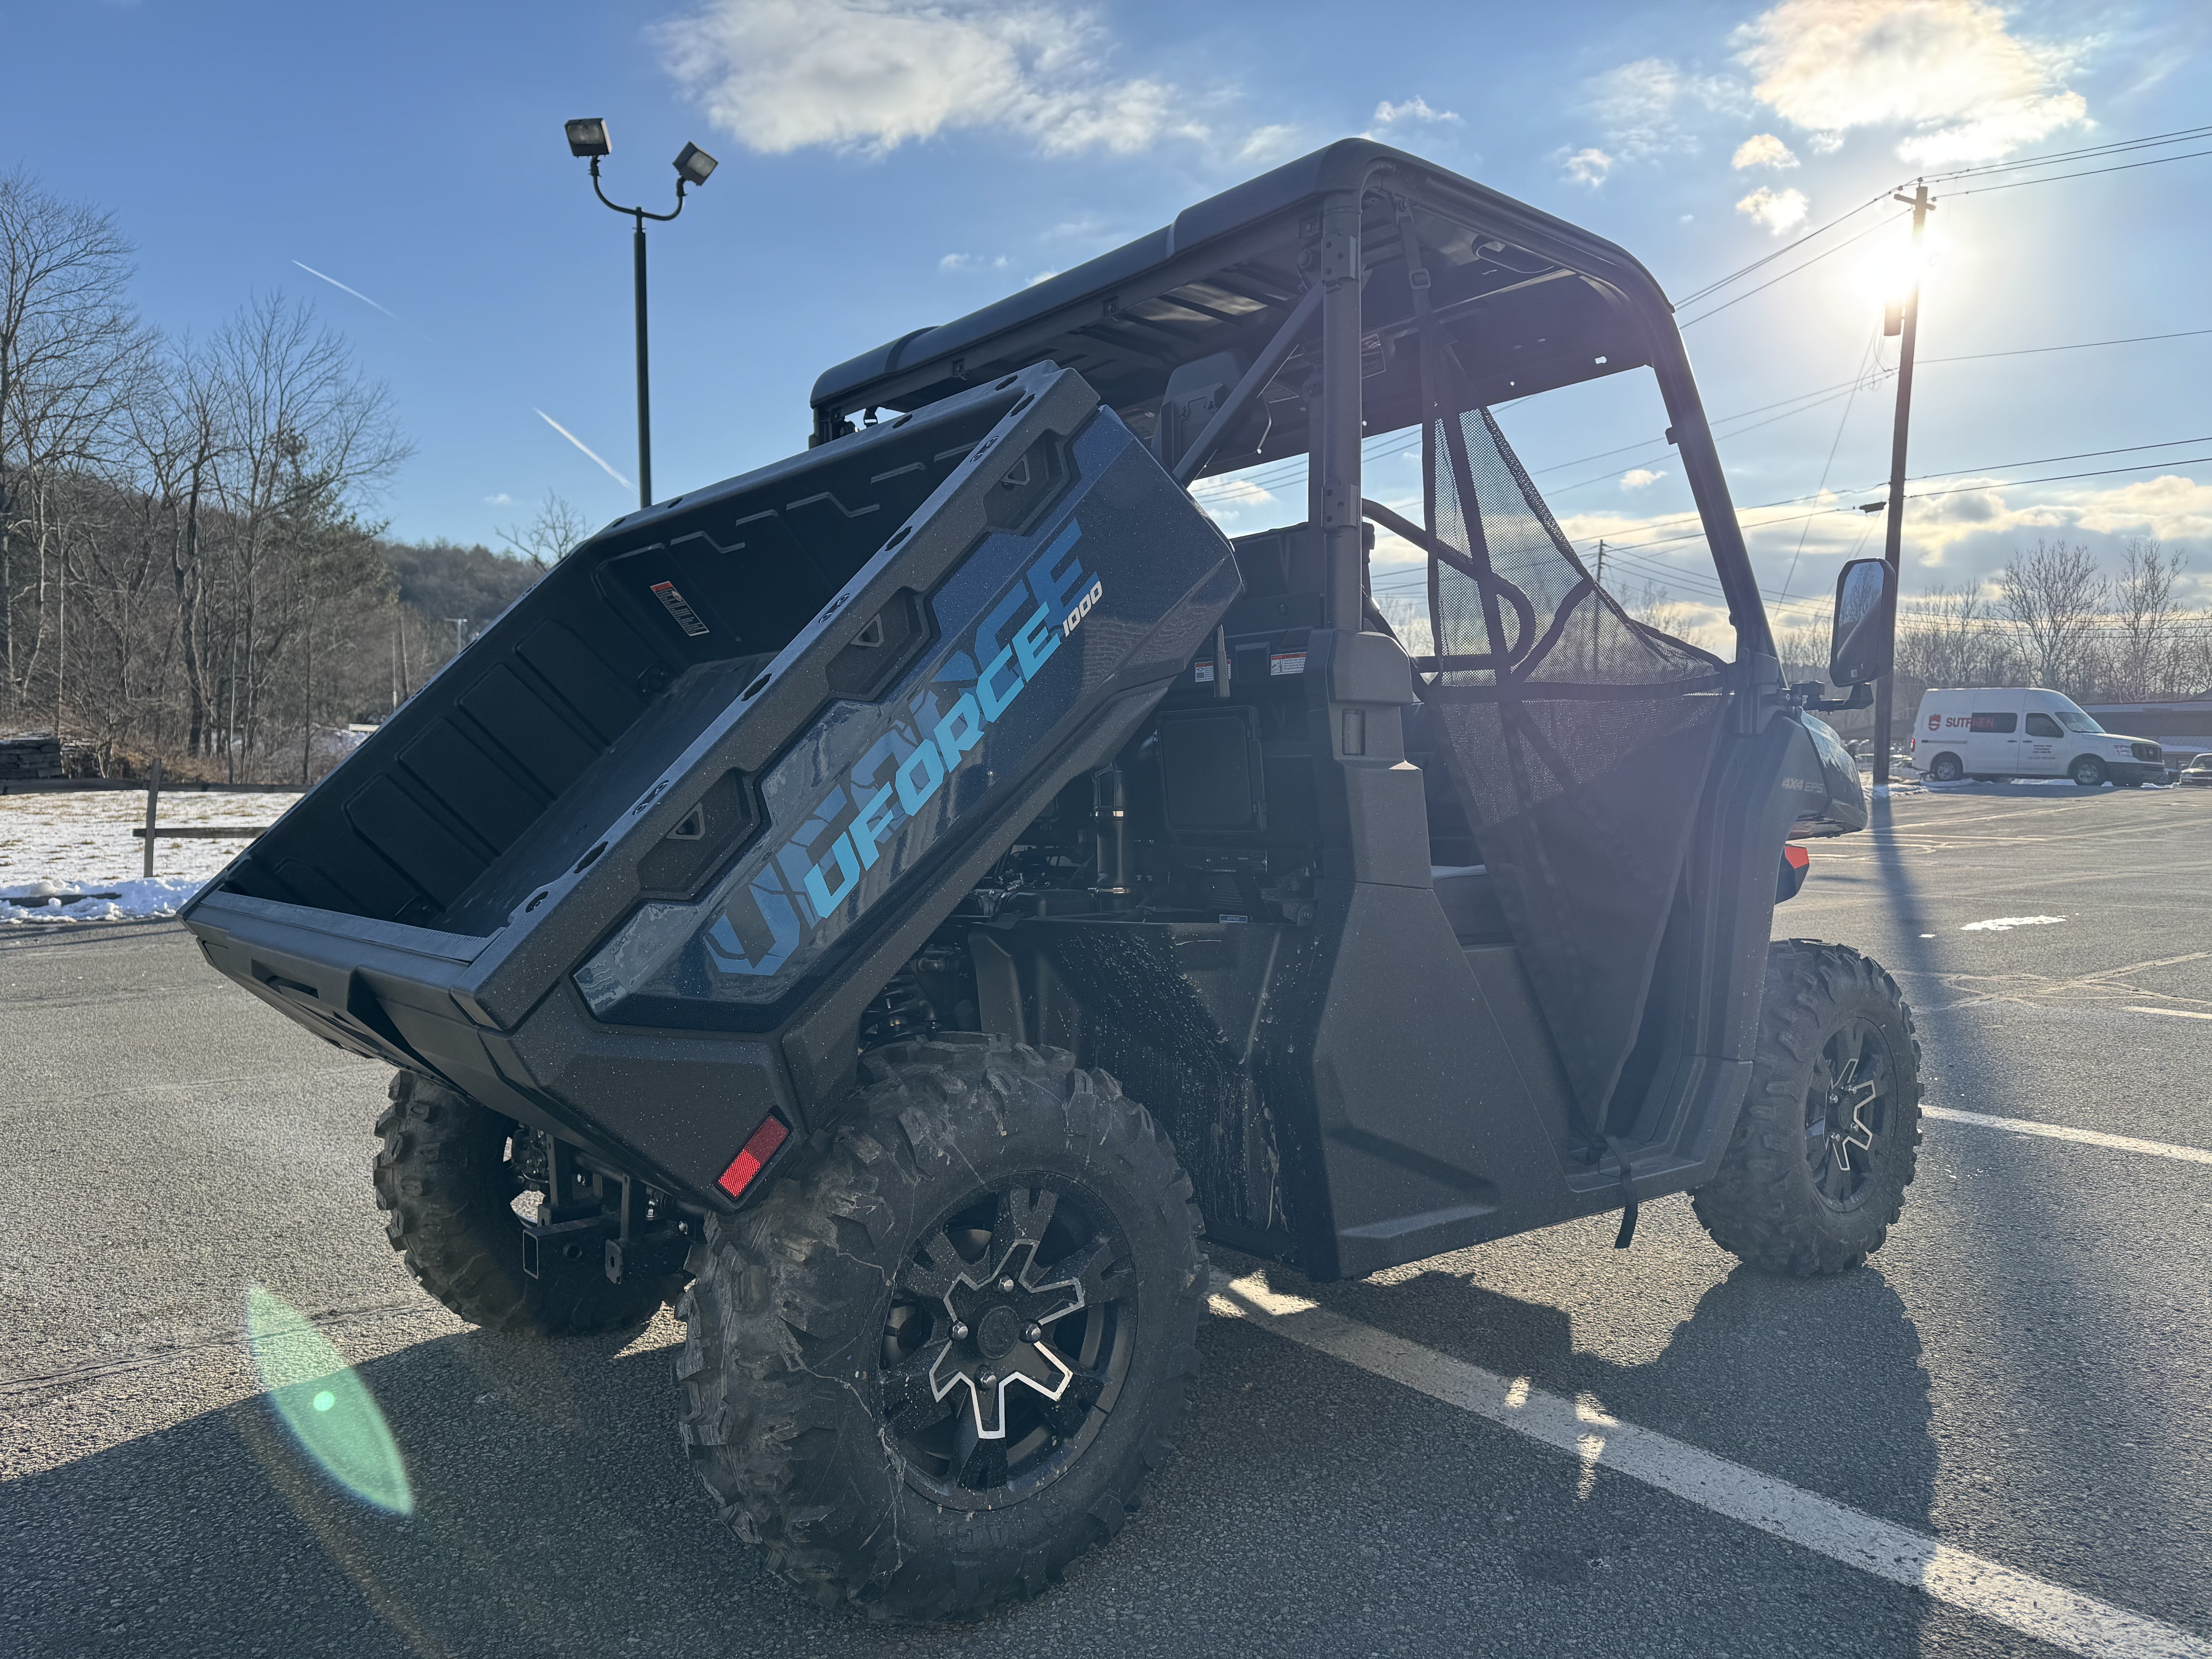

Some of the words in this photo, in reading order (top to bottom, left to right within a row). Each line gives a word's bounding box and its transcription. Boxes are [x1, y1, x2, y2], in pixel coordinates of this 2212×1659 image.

[1946, 717, 1994, 728] SUTPHEN
[803, 601, 1062, 919] UFORCE
[1063, 581, 1103, 637] 1000
[1804, 781, 1825, 793] EPS
